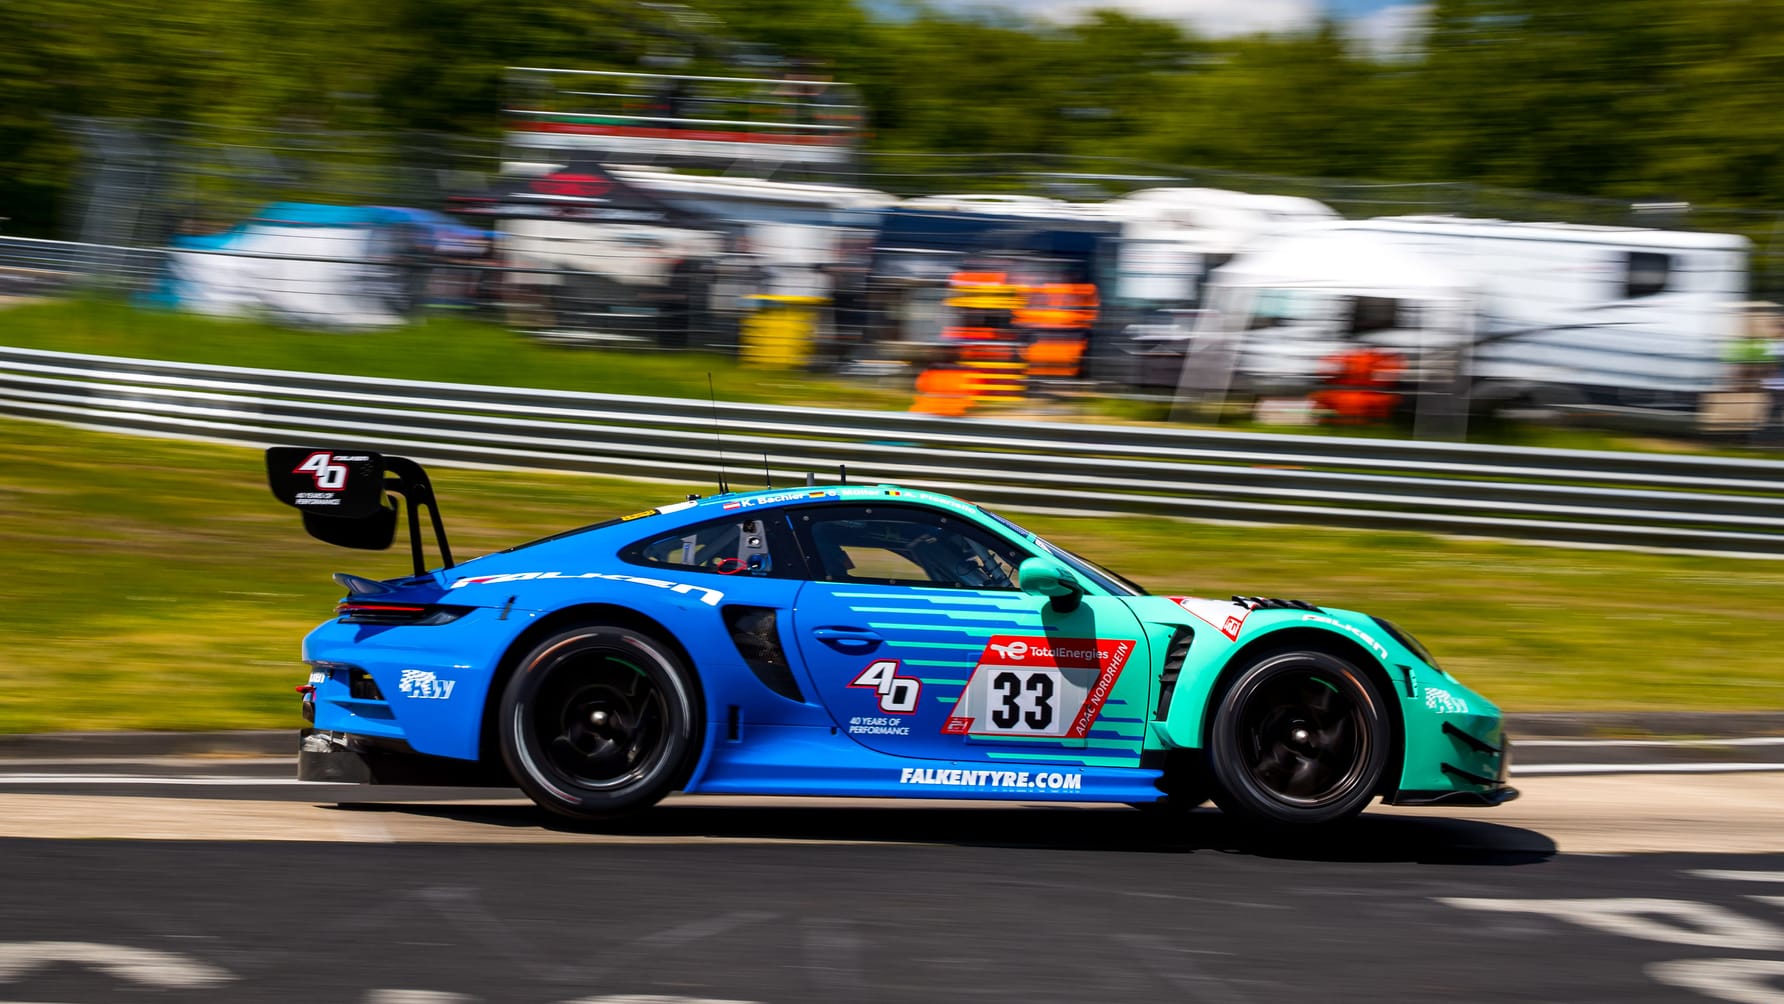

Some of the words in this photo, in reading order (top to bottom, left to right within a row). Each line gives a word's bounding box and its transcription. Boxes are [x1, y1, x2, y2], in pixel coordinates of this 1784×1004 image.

[295, 452, 348, 490] 40
[741, 499, 755, 508] K.
[758, 492, 804, 505] Bachler
[450, 571, 724, 606] FALKEN
[1030, 646, 1109, 661] TotalEnergies
[1302, 614, 1388, 659] FALKEN
[848, 659, 922, 714] 40
[992, 672, 1054, 730] 33
[1075, 704, 1096, 736] ADAC
[1091, 642, 1129, 706] NORDRHEIN
[849, 717, 861, 725] 40
[862, 717, 888, 726] YEARS
[888, 718, 901, 726] OF
[849, 725, 910, 736] PERFORMANCE
[900, 768, 1082, 789] FALKENTYRE.COM
